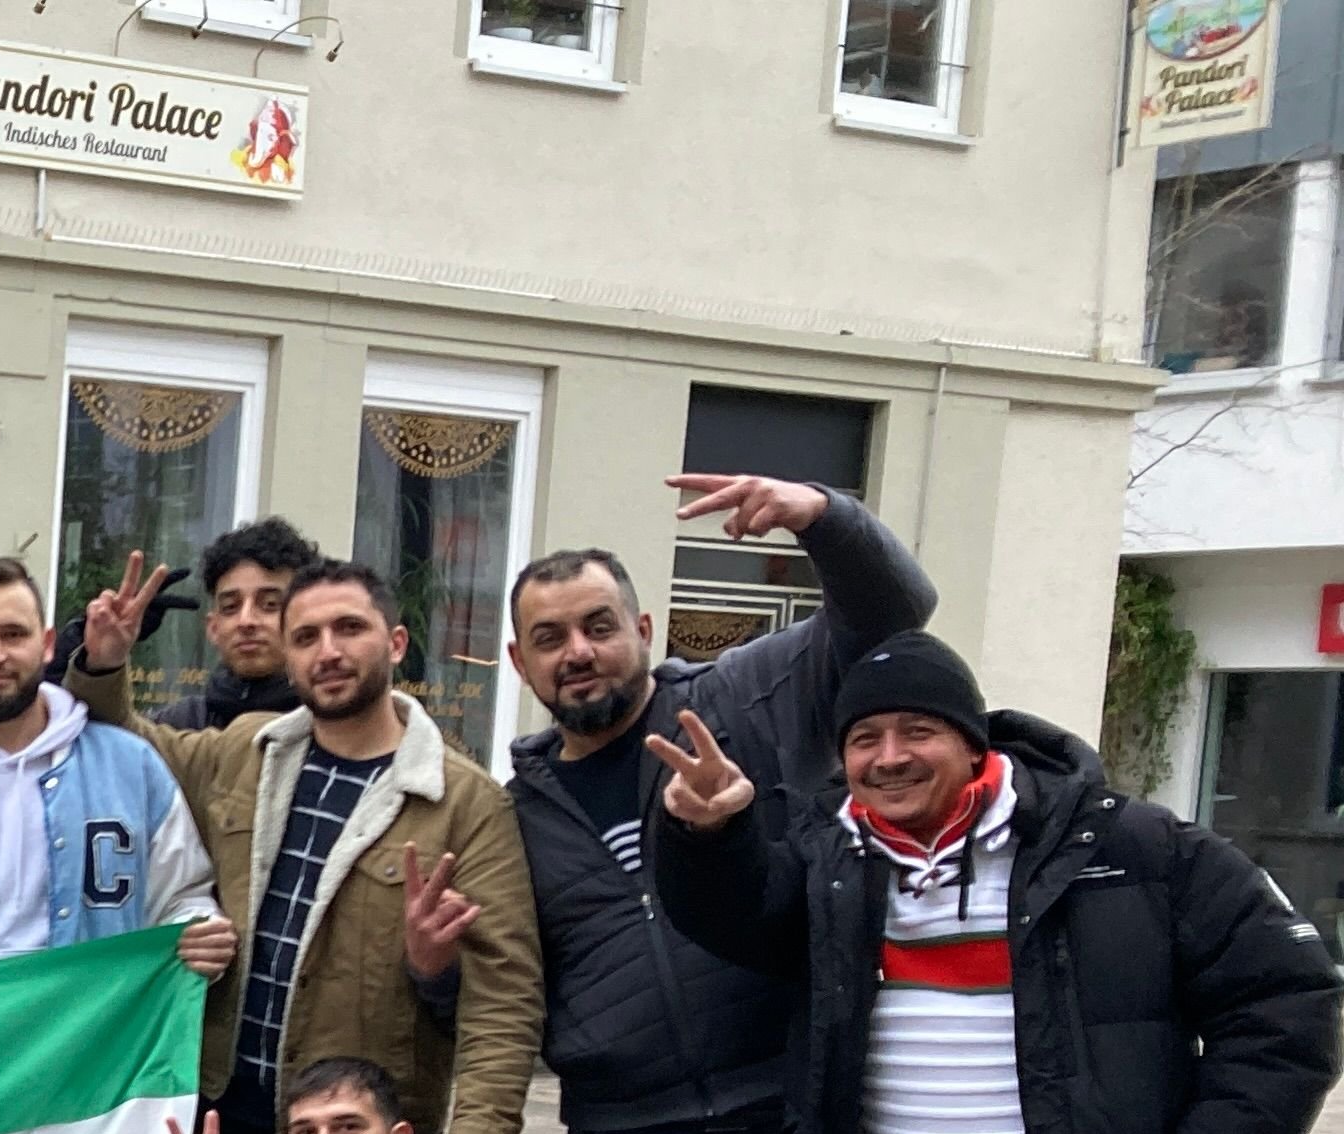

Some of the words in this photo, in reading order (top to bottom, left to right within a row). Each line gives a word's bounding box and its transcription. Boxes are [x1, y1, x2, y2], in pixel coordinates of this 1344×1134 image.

[1159, 54, 1248, 89] Pandori
[108, 82, 223, 140] Palace
[1165, 87, 1237, 114] Palace
[3, 121, 78, 150] Indisches
[83, 132, 168, 162] Restaurant
[82, 818, 134, 908] C
